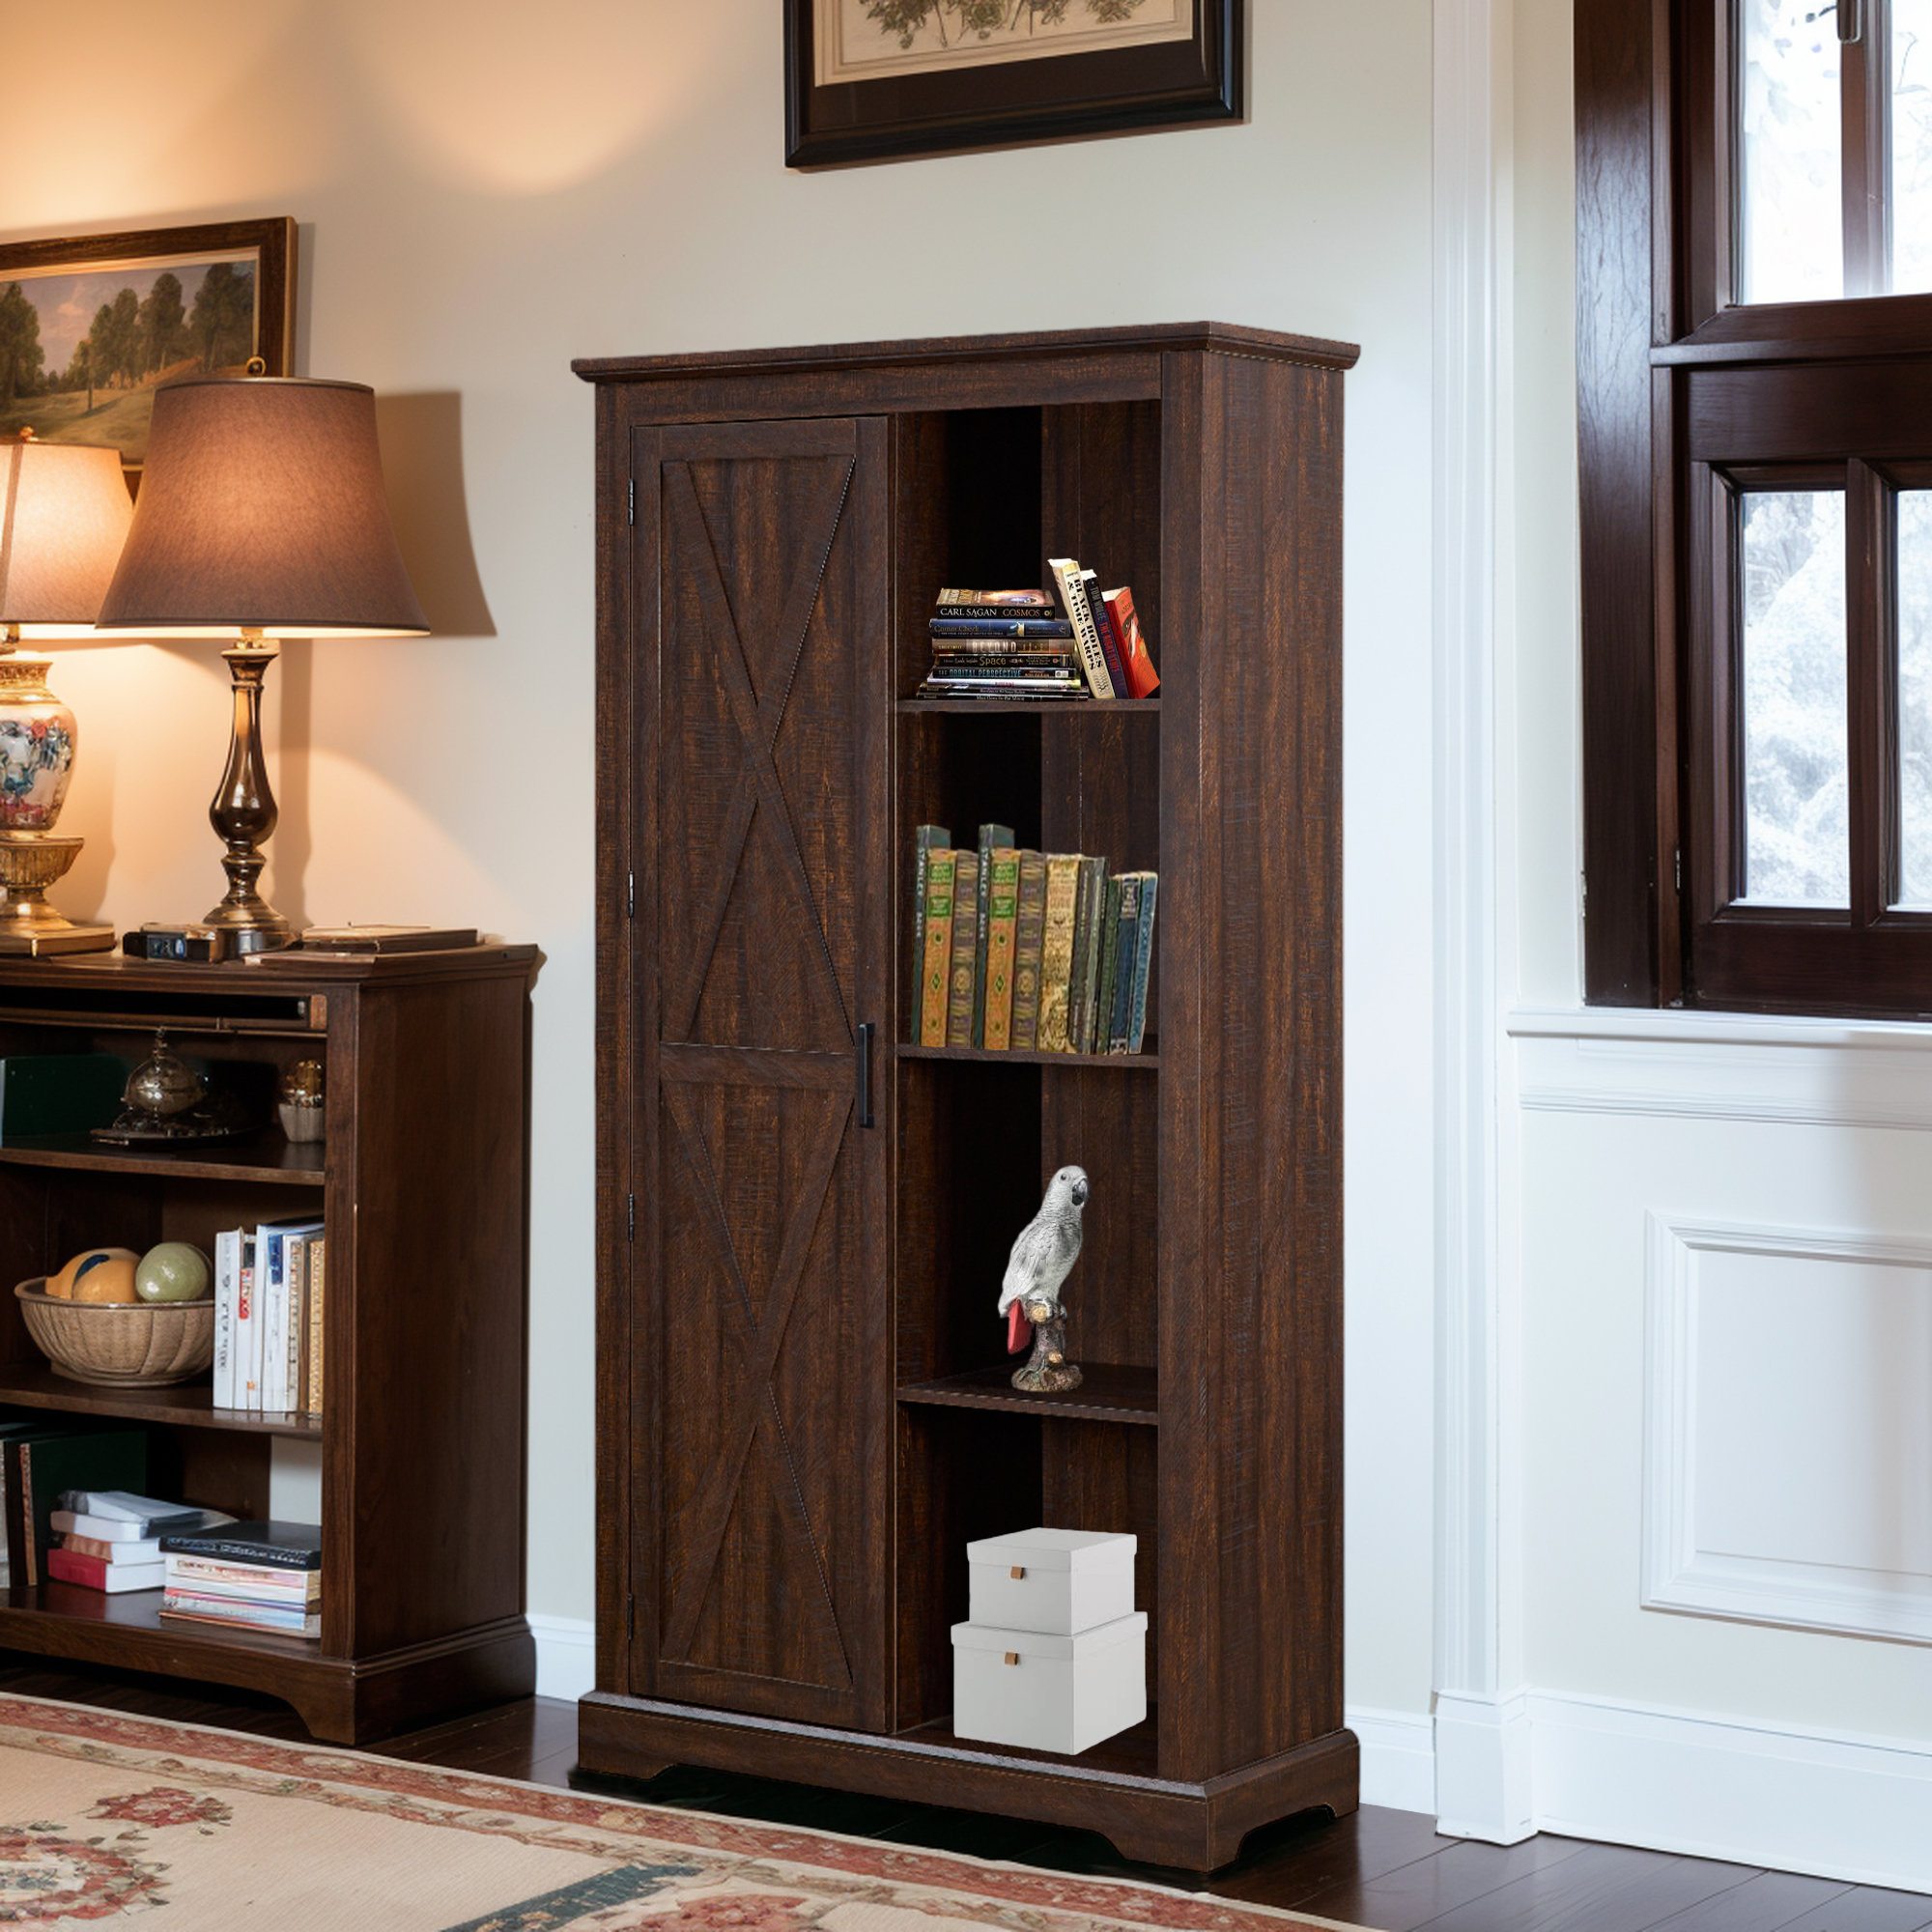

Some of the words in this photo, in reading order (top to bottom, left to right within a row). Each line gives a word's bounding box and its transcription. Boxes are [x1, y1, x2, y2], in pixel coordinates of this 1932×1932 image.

[940, 608, 964, 616] CARL
[966, 608, 997, 617] SAGAN
[1002, 609, 1040, 617] COSMOS
[1067, 581, 1074, 591] &
[1071, 596, 1084, 626] TIME
[1081, 627, 1095, 670] WARPS
[1074, 579, 1090, 621] BLACK
[1087, 625, 1102, 668] HOLES
[1099, 622, 1111, 634] THE
[972, 641, 1017, 653] BEYOND
[1101, 635, 1115, 654] RIGHT
[979, 656, 1006, 666] Space
[917, 848, 925, 896] STANLEY
